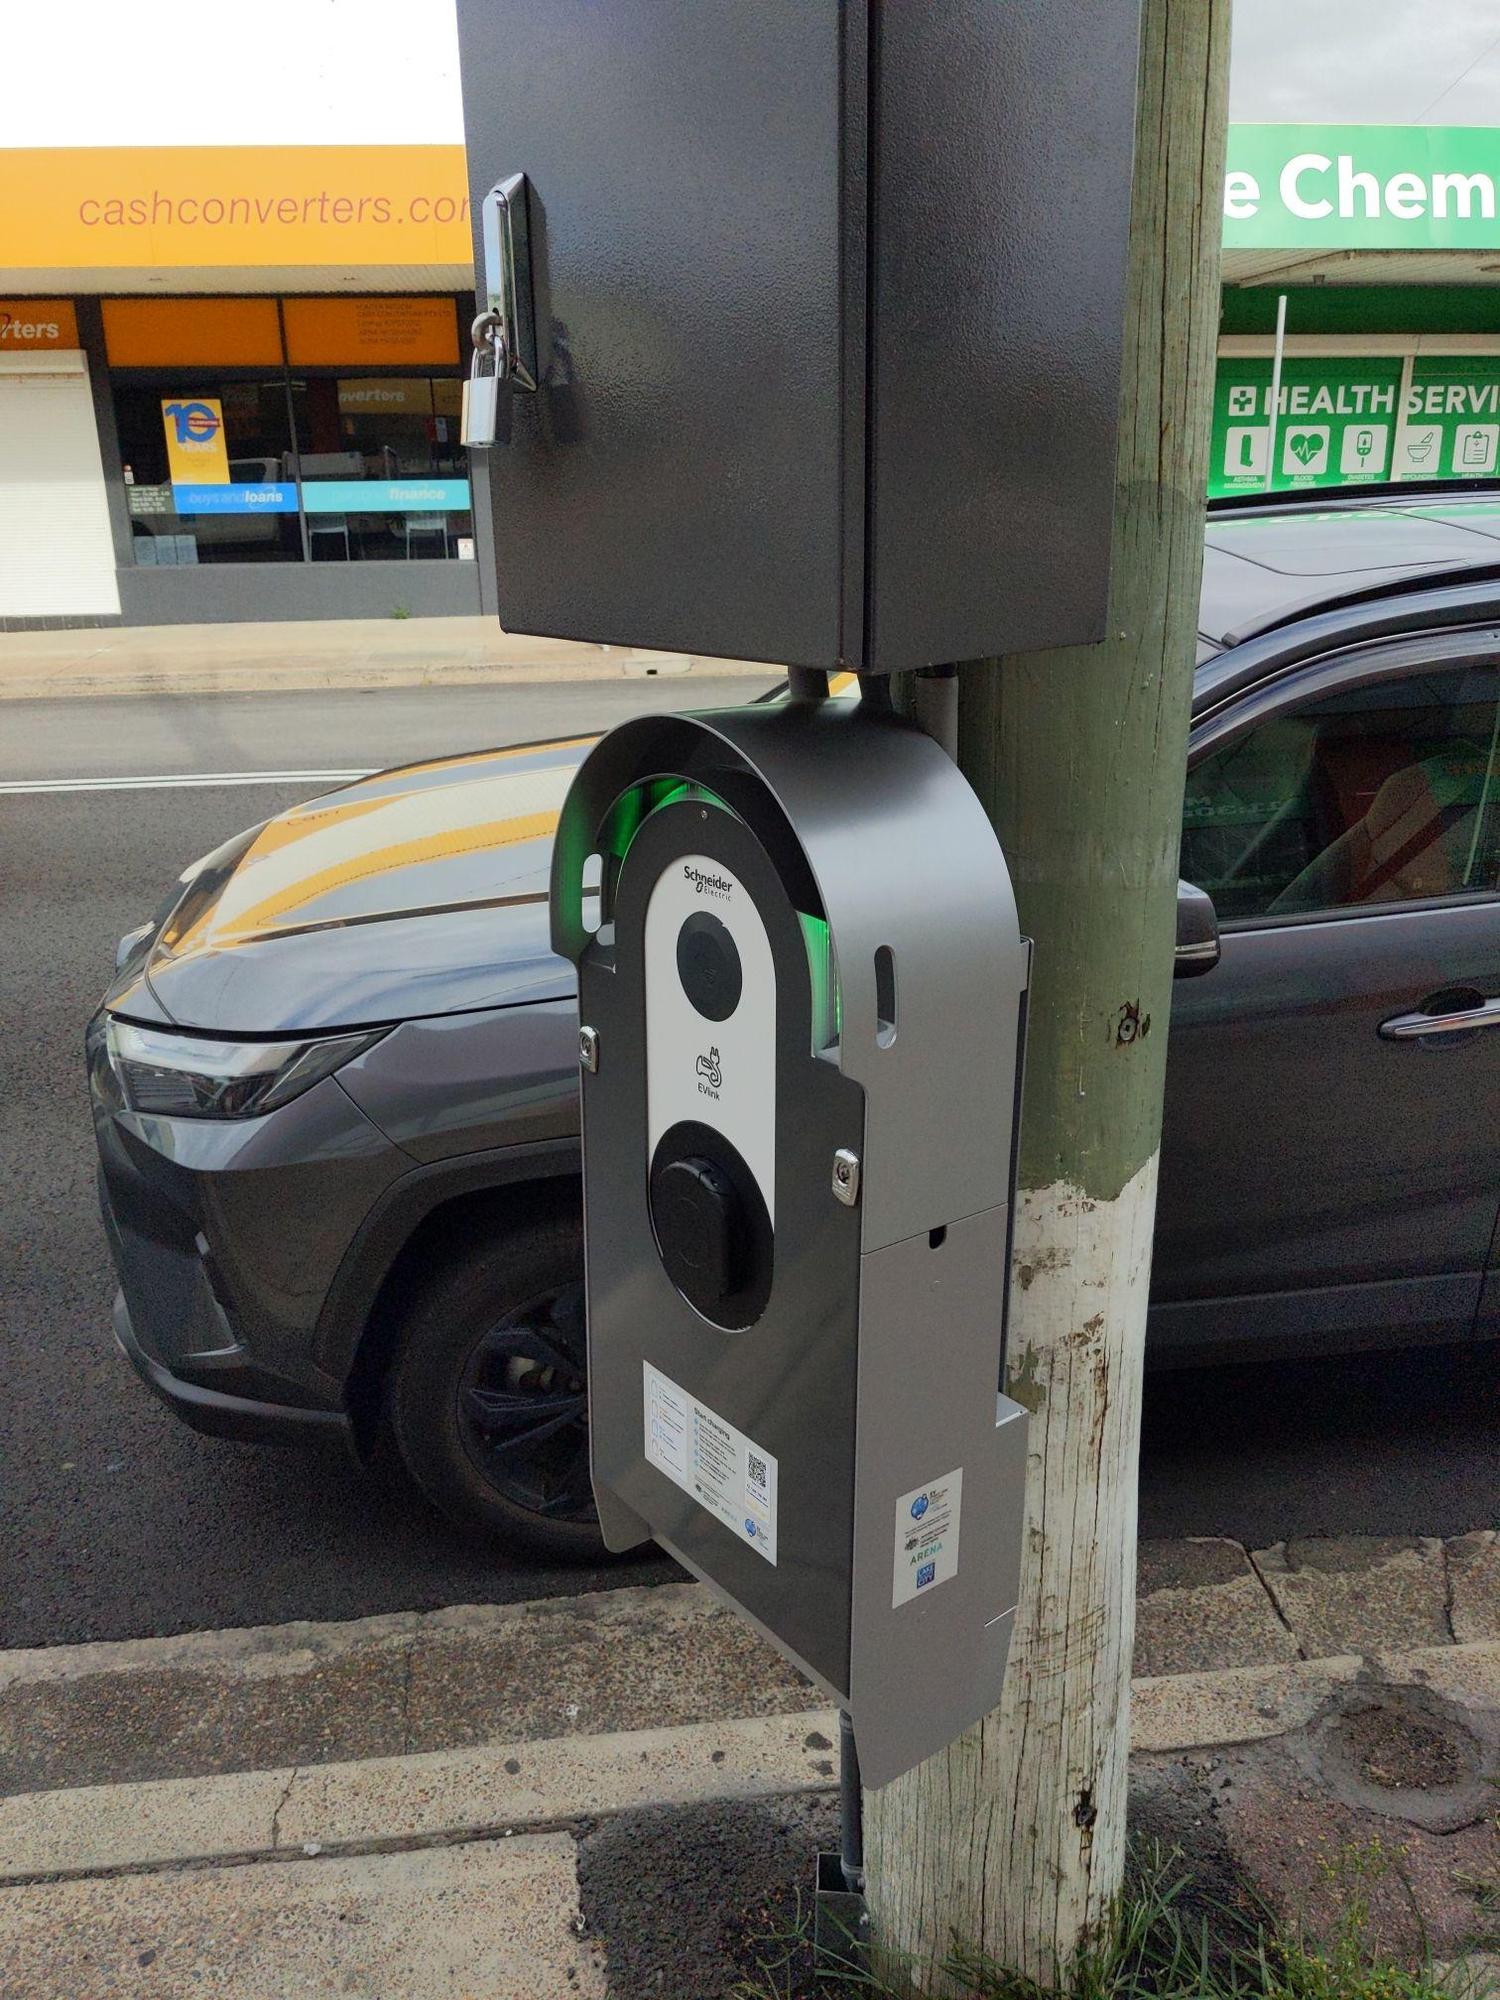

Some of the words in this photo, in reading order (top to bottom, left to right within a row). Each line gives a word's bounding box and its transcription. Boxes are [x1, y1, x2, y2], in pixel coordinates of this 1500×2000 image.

[1224, 171, 1260, 219] e
[1279, 153, 1496, 219] Chem
[79, 191, 468, 226] cashconverters.co
[1264, 385, 1395, 415] HEALTH
[1409, 385, 1500, 414] SERVI
[165, 403, 217, 443] 10
[245, 489, 283, 503] loans
[684, 866, 733, 892] Schneider
[704, 886, 731, 902] Electric
[698, 1082, 720, 1101] EVlink
[909, 1543, 943, 1566] ARENA
